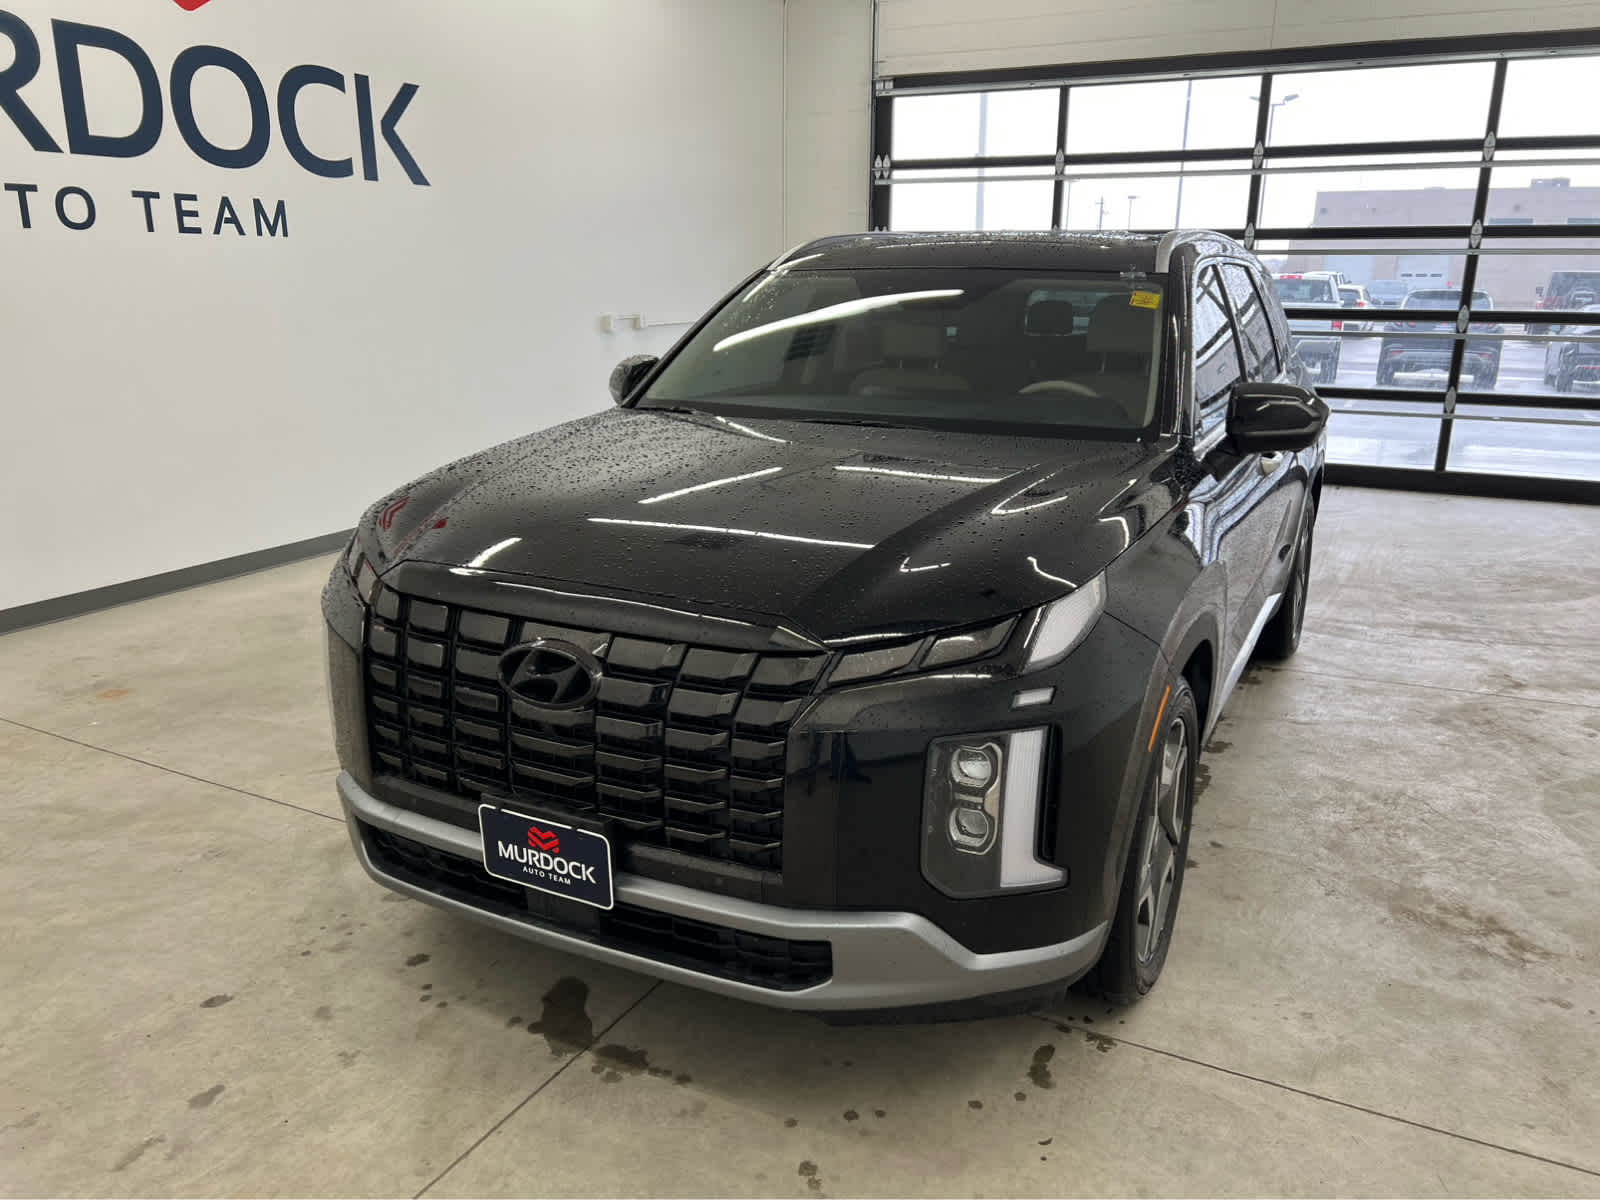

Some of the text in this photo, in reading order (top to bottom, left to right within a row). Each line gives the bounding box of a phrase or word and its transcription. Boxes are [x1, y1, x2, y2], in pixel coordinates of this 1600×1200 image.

[4, 183, 289, 238] TO TEAM
[498, 840, 596, 884] MURDOCK
[523, 866, 571, 884] AUTO TEAM
